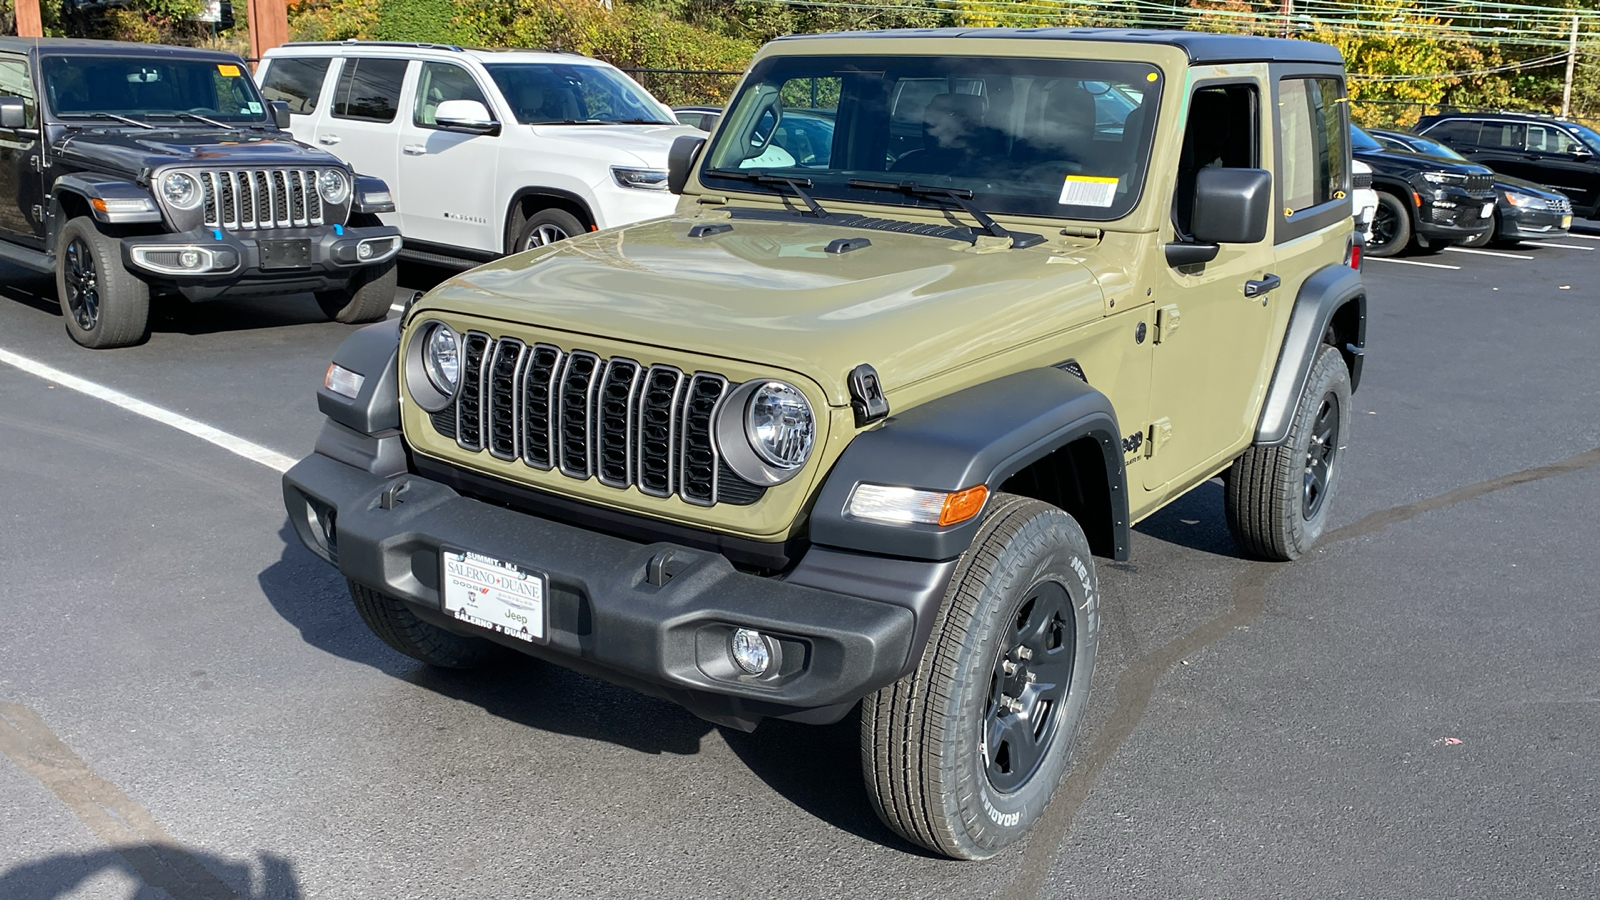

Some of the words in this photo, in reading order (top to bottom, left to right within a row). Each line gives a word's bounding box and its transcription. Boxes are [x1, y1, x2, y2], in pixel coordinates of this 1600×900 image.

[448, 561, 496, 585] SALERNO
[501, 576, 540, 599] DUANE
[505, 562, 518, 572] NJ
[1070, 556, 1095, 633] NEXEN
[454, 611, 493, 629] SALERNO
[504, 626, 533, 643] DUANE
[505, 609, 528, 625] Jeep
